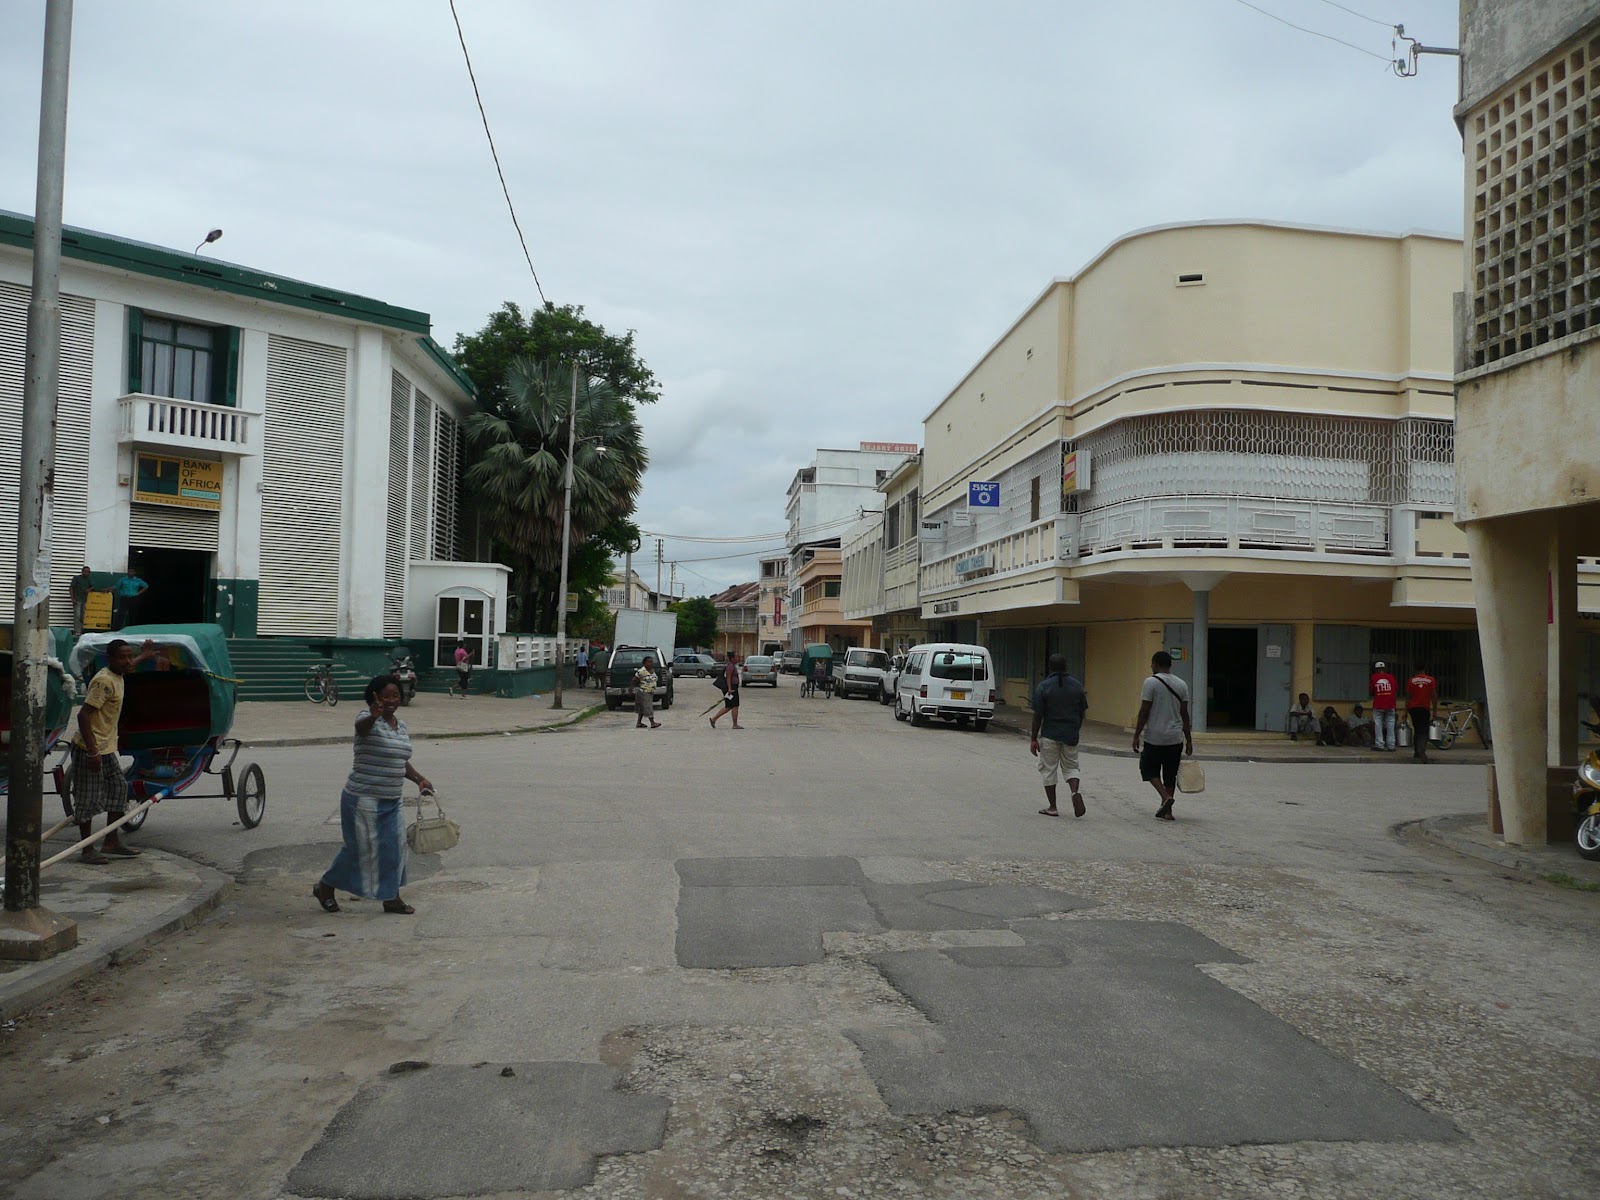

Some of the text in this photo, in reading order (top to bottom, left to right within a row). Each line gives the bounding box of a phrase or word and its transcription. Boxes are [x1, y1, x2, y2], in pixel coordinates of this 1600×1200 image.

[894, 445, 917, 453] HOTEL
[183, 460, 212, 471] BANK
[181, 469, 197, 477] OF
[181, 478, 221, 490] AFRICA
[972, 483, 997, 491] SKF
[182, 490, 219, 499] MADAGASCAR
[1375, 683, 1392, 692] THB
